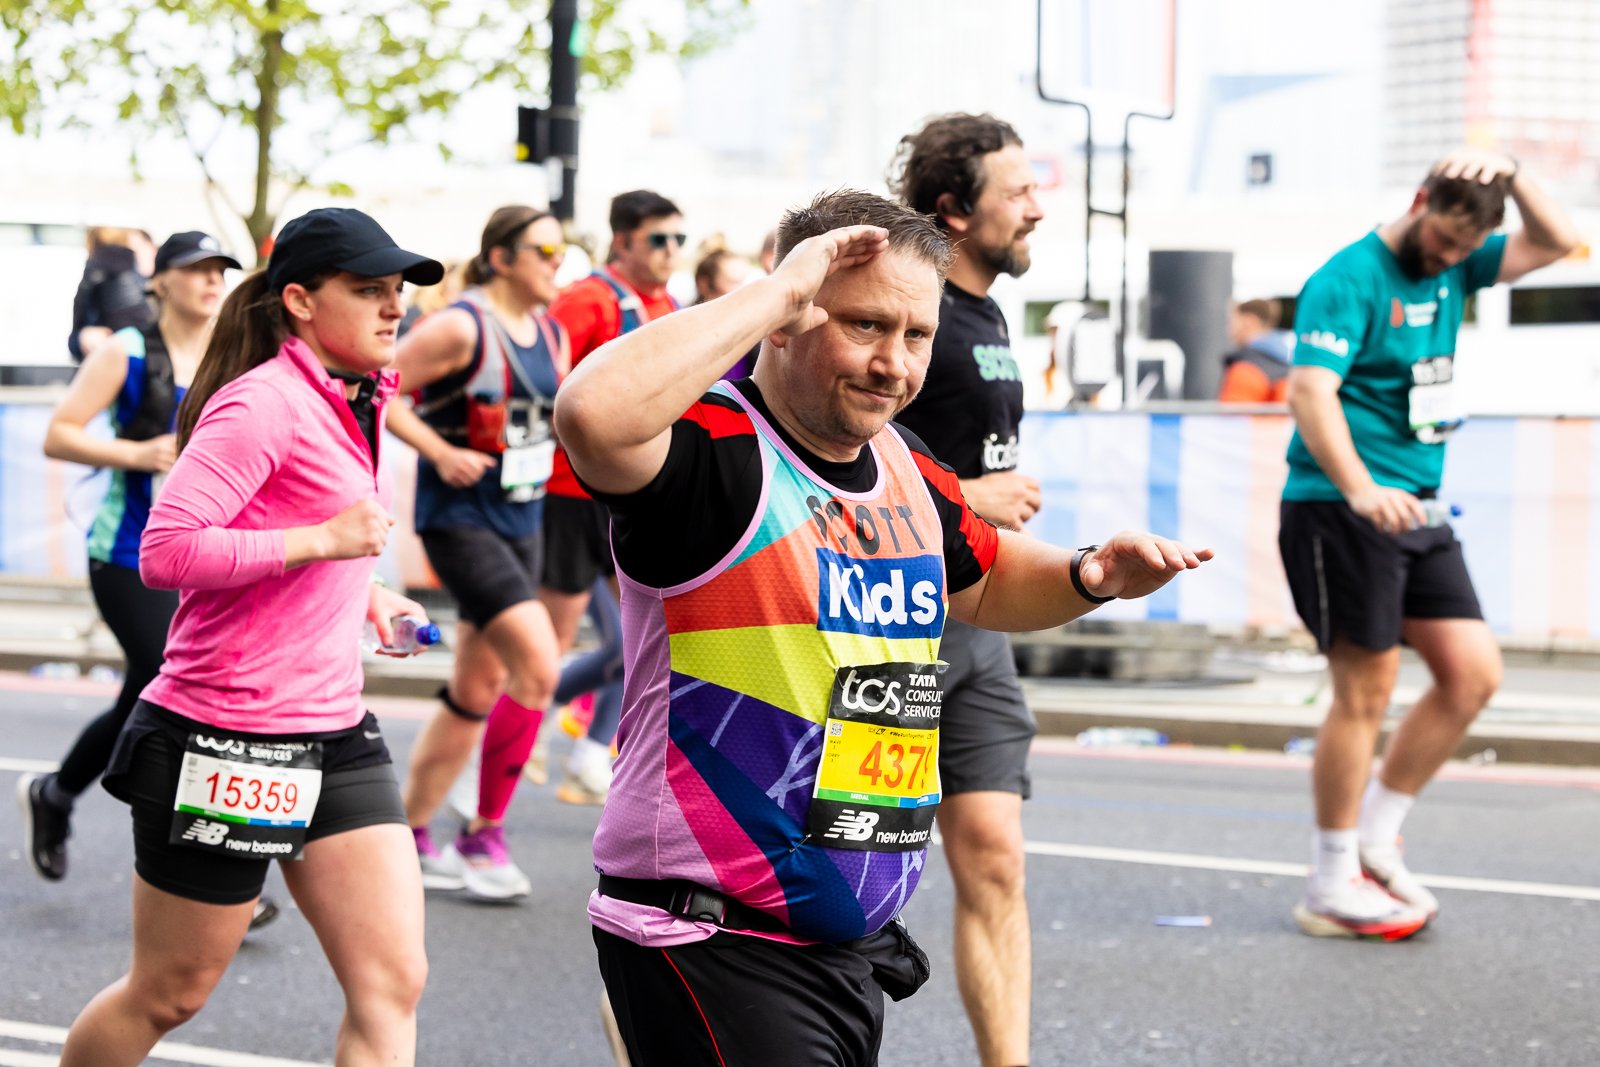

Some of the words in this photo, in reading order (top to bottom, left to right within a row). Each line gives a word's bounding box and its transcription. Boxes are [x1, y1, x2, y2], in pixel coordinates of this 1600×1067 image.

[828, 562, 938, 626] Kids
[909, 673, 937, 688] TATA
[841, 669, 901, 716] tcs
[205, 771, 298, 814] 15359
[850, 793, 869, 801] MEDAL
[875, 831, 900, 844] new
[225, 838, 252, 852] new
[251, 840, 293, 854] balance
